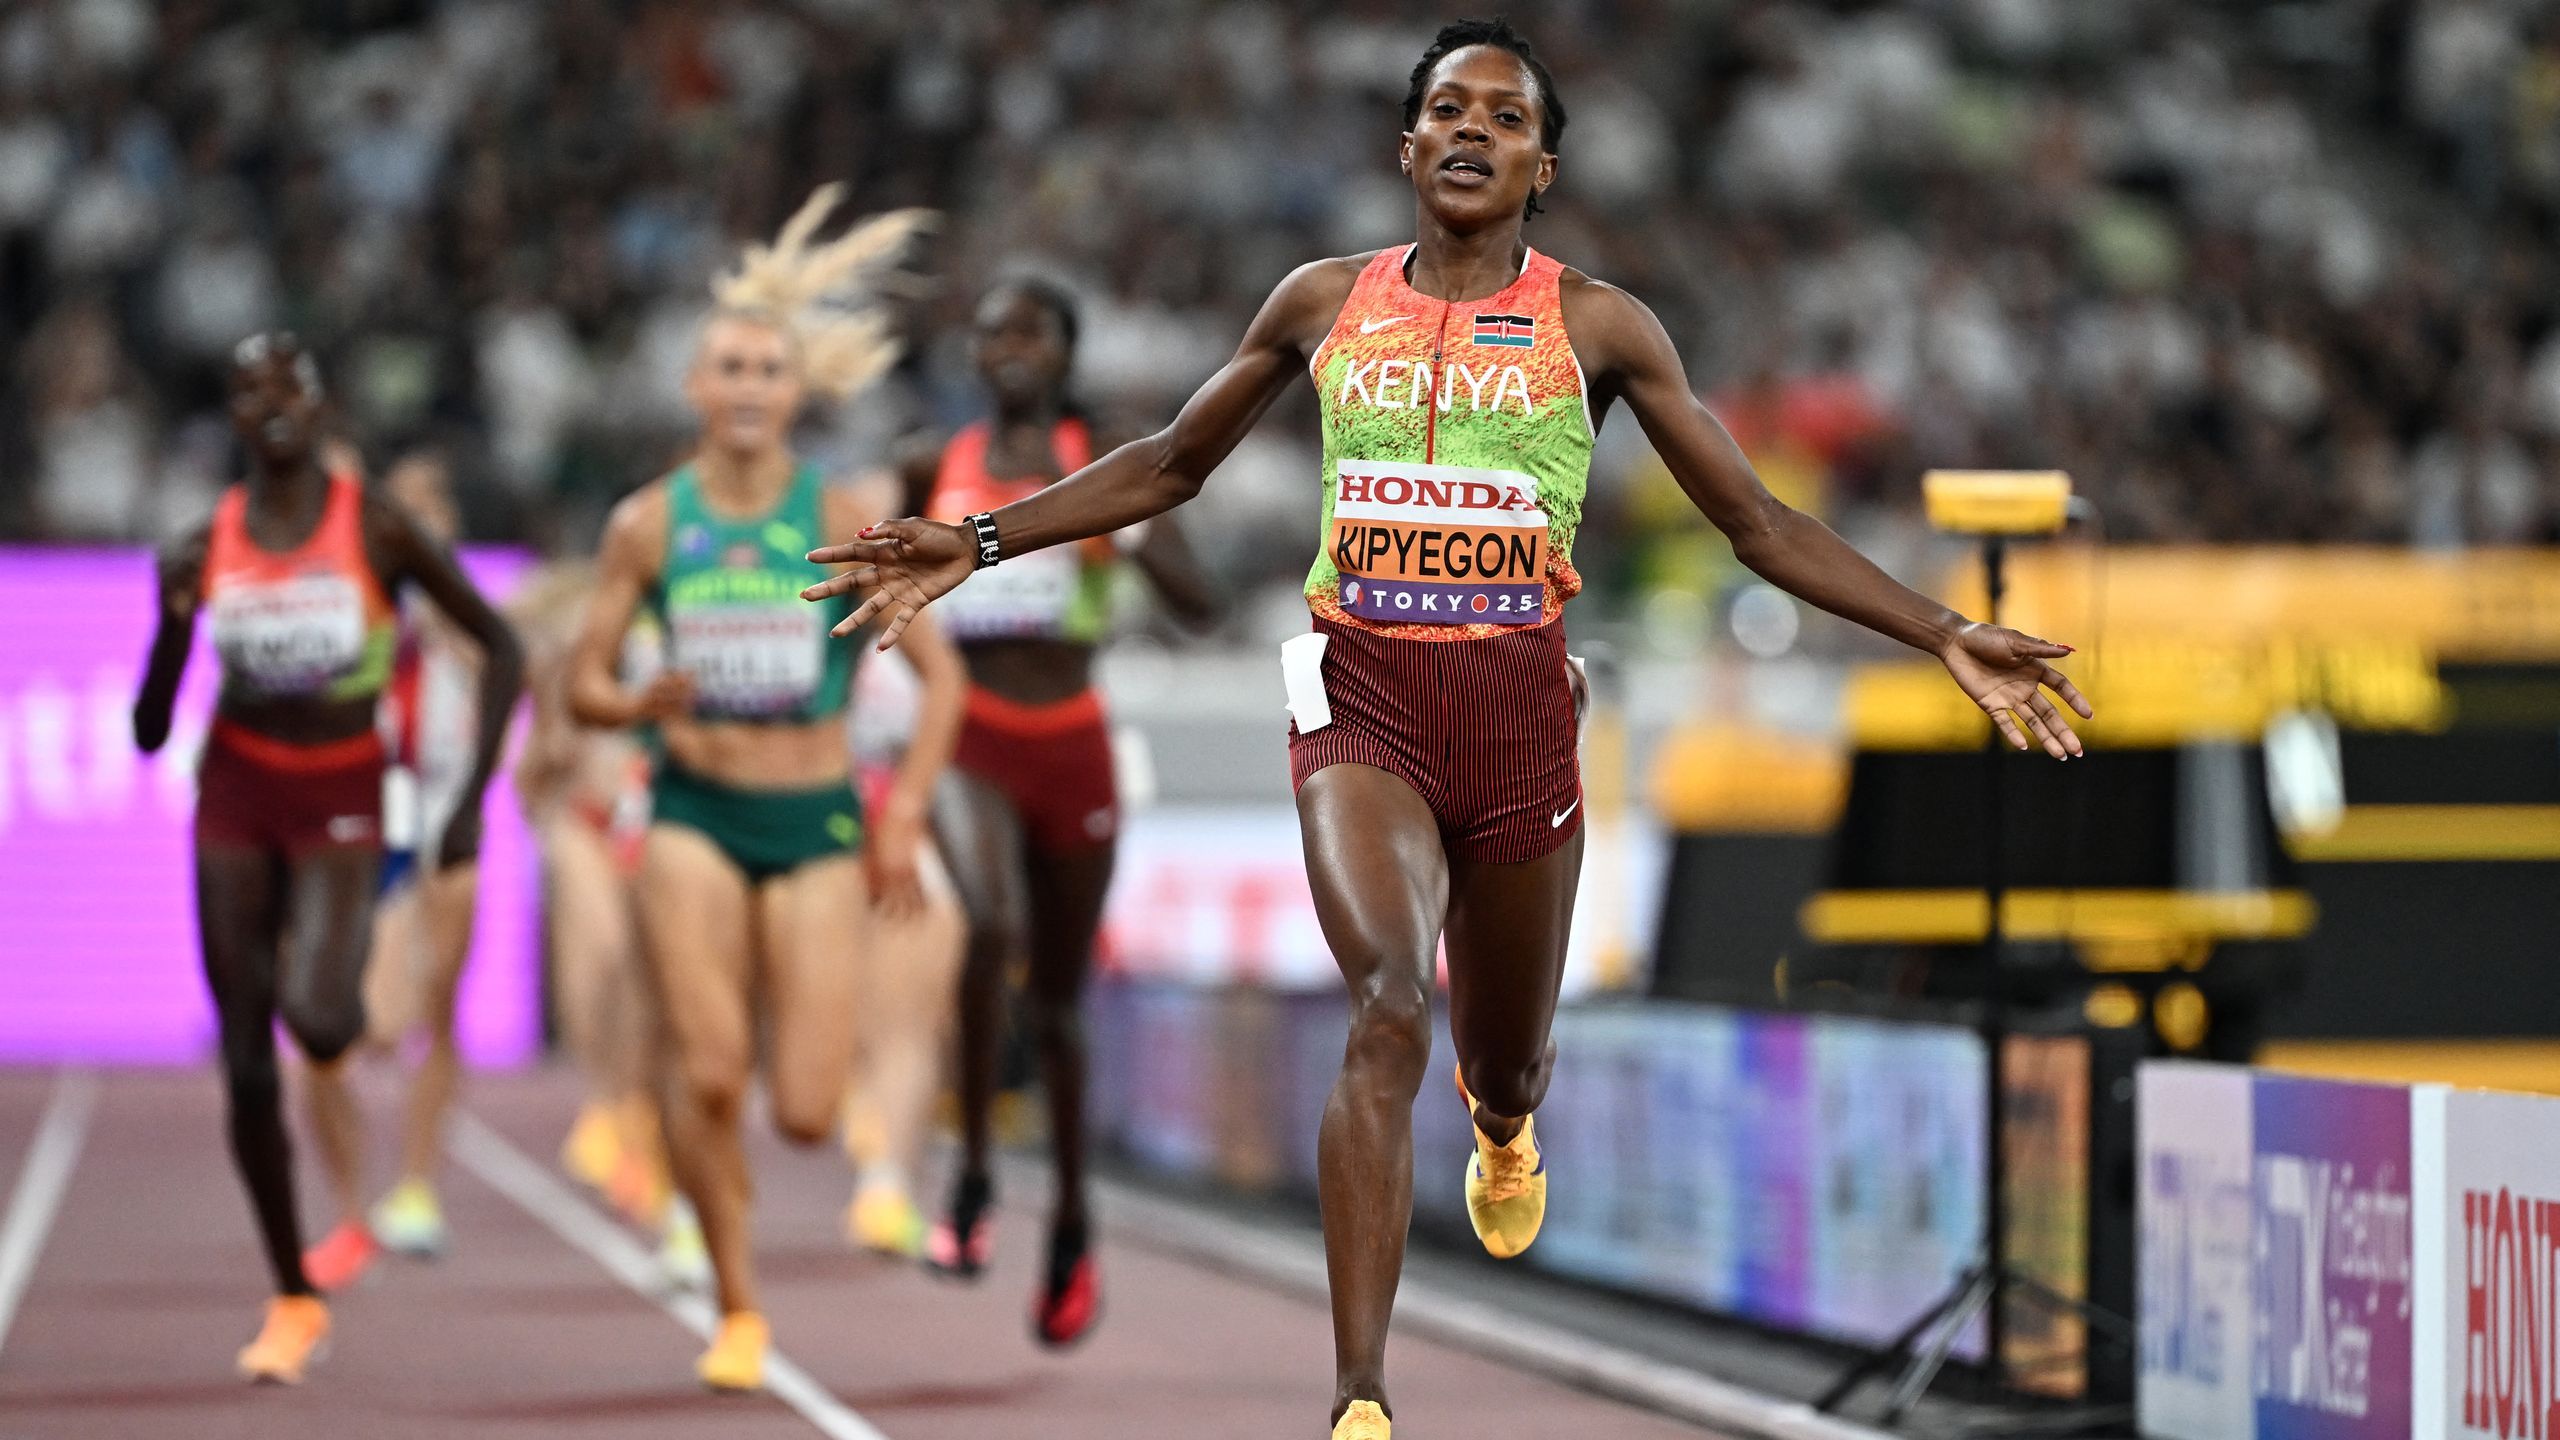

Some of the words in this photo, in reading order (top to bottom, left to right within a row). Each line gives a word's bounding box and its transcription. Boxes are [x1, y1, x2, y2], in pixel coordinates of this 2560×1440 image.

[1340, 359, 1533, 416] KENYA
[1339, 475, 1538, 511] HONDA
[1336, 525, 1537, 579] KIPYEGON
[1497, 594, 1533, 612] 25
